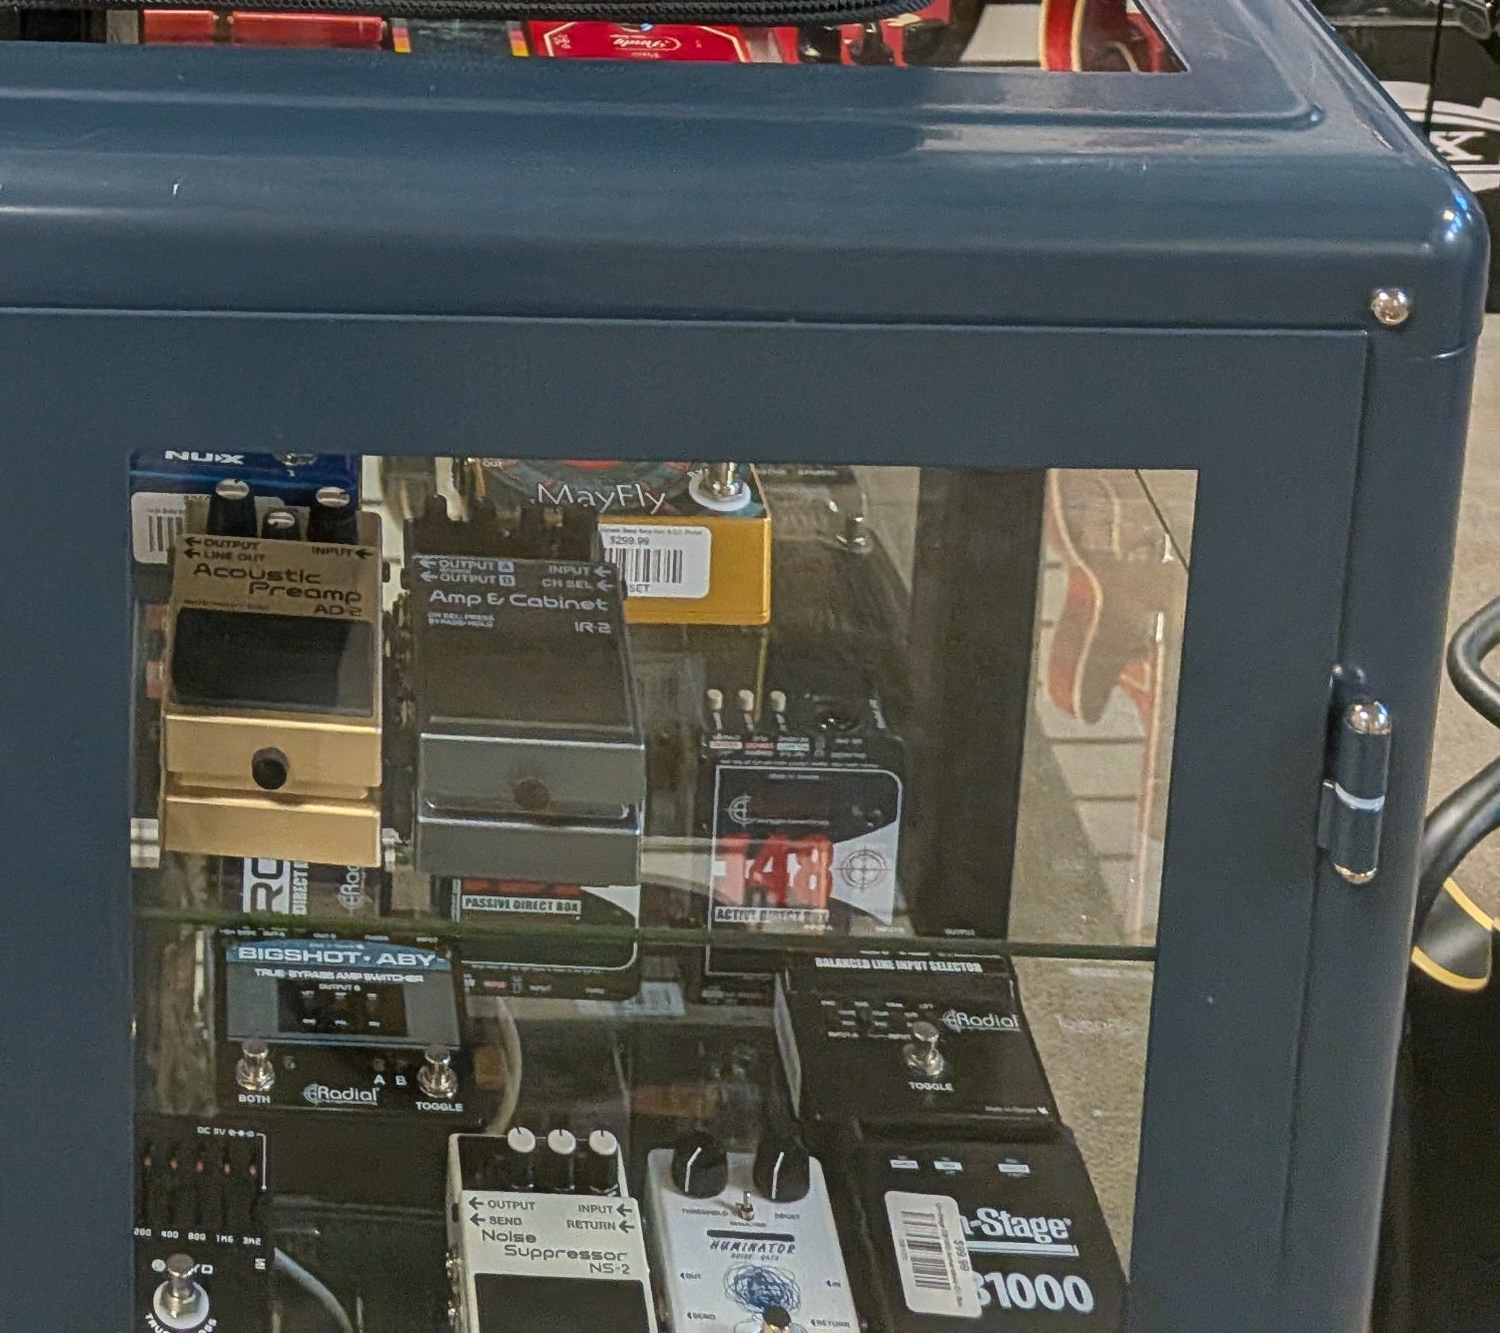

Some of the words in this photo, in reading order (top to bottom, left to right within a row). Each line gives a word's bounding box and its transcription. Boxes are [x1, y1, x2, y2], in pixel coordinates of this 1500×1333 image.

[537, 483, 666, 515] MayFly
[204, 538, 261, 550] OUTPUT
[203, 551, 232, 561] LINE
[236, 553, 266, 563] OUT
[311, 546, 354, 556] INPUT
[438, 559, 495, 570] OUTPUT
[548, 565, 590, 575] INPUT
[193, 562, 322, 584] Acoustic
[439, 573, 497, 584] OUTPUT
[249, 581, 363, 605] Preamp
[429, 589, 482, 608] Amp
[509, 593, 609, 612] Cabinet
[513, 899, 553, 911] DIRECT
[238, 946, 363, 964] BIGSHOT
[376, 952, 437, 967] ABY
[814, 957, 871, 969] BALANCED
[872, 960, 895, 970] LINE
[896, 960, 928, 972] INPUT
[929, 961, 984, 973] SELECTOR
[956, 1012, 1020, 1031] Radial
[908, 1081, 954, 1092] TOGGLE
[237, 1094, 271, 1104] BOTH
[317, 1085, 380, 1102] Radial
[416, 1101, 464, 1113] TOGGLE
[487, 1199, 536, 1211] OUTPUT
[578, 1204, 614, 1214] INPUT
[489, 1215, 523, 1226] SEND
[566, 1219, 616, 1231] RETURN
[959, 1207, 1070, 1245] n-Stage
[481, 1229, 537, 1244] Noise
[504, 1244, 628, 1262] Suppressor
[709, 1240, 797, 1255] HUMINATOR
[589, 1262, 630, 1275] NS-2
